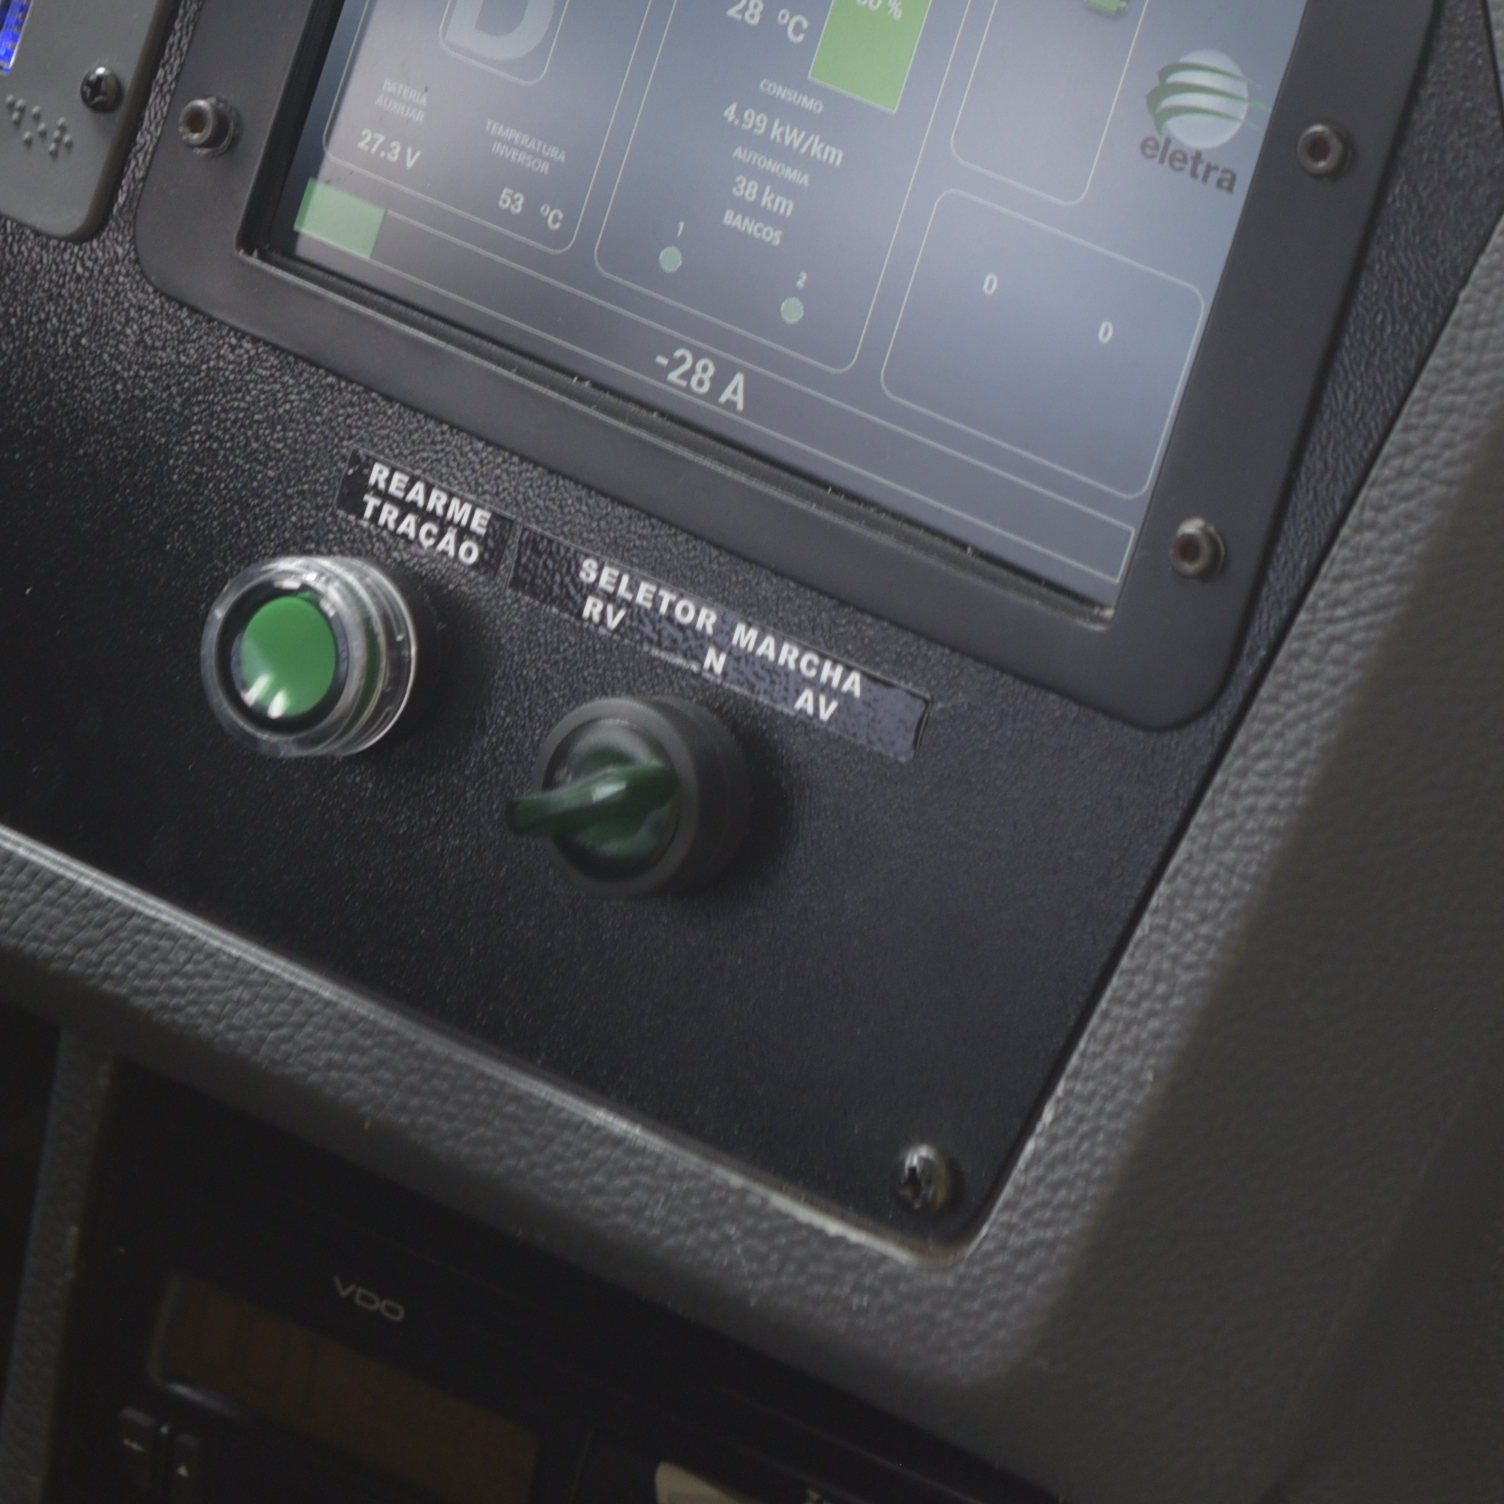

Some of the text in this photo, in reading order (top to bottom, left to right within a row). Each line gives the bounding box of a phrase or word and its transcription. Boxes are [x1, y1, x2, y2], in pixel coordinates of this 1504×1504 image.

[374, 94, 426, 123] AUXILIAR
[382, 77, 428, 107] BATERIA
[759, 78, 824, 114] CONSUMO
[357, 128, 422, 169] 27.3 V
[485, 118, 566, 163] TEMPERATURA
[723, 101, 845, 168] 4.99 kW/km
[491, 140, 550, 176] INVERSOR
[732, 146, 810, 187] AUTONOMIA
[1139, 134, 1238, 194] eletra
[732, 174, 795, 219] 38 km
[676, 221, 685, 237] 1
[722, 209, 784, 247] BANCOS
[796, 271, 808, 289] 2
[655, 348, 745, 412] -28 A
[368, 462, 492, 536] REARME
[363, 494, 479, 565] TRAÇÃO
[579, 557, 863, 699] SELETOR MARCHA
[582, 595, 838, 722] RV N AV
[334, 1274, 405, 1322] VDO
